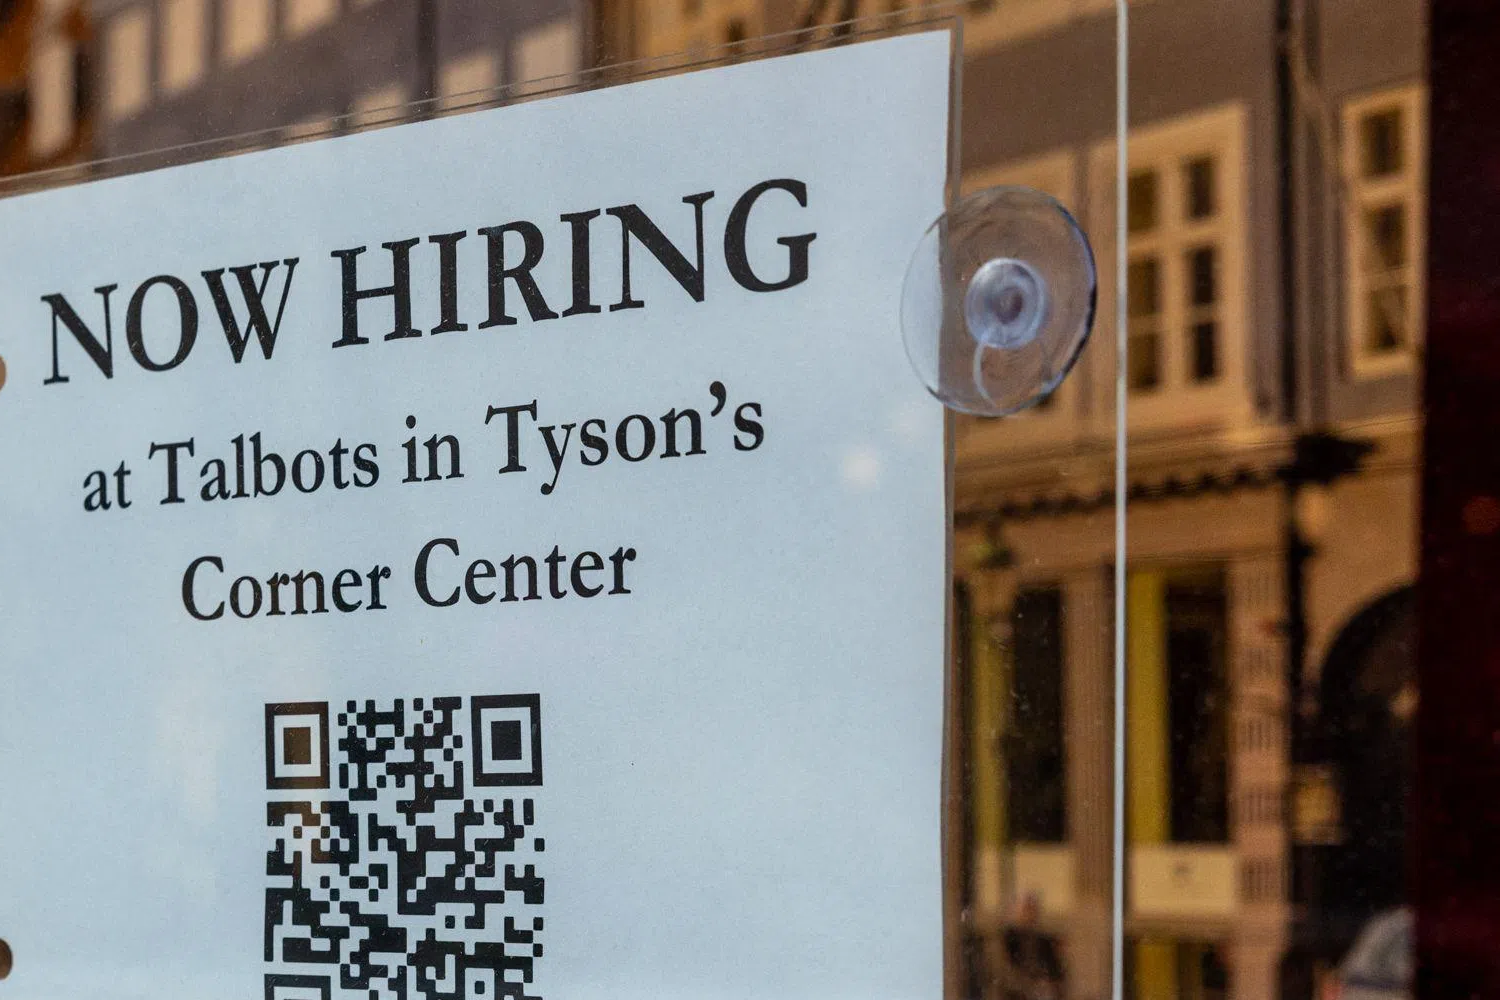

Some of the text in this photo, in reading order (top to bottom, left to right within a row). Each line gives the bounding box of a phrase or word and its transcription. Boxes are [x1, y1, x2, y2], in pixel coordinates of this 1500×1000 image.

[41, 178, 818, 385] NOW HIRING
[82, 380, 765, 512] at Talbots in Tyson’s
[181, 537, 637, 622] Corner Center
